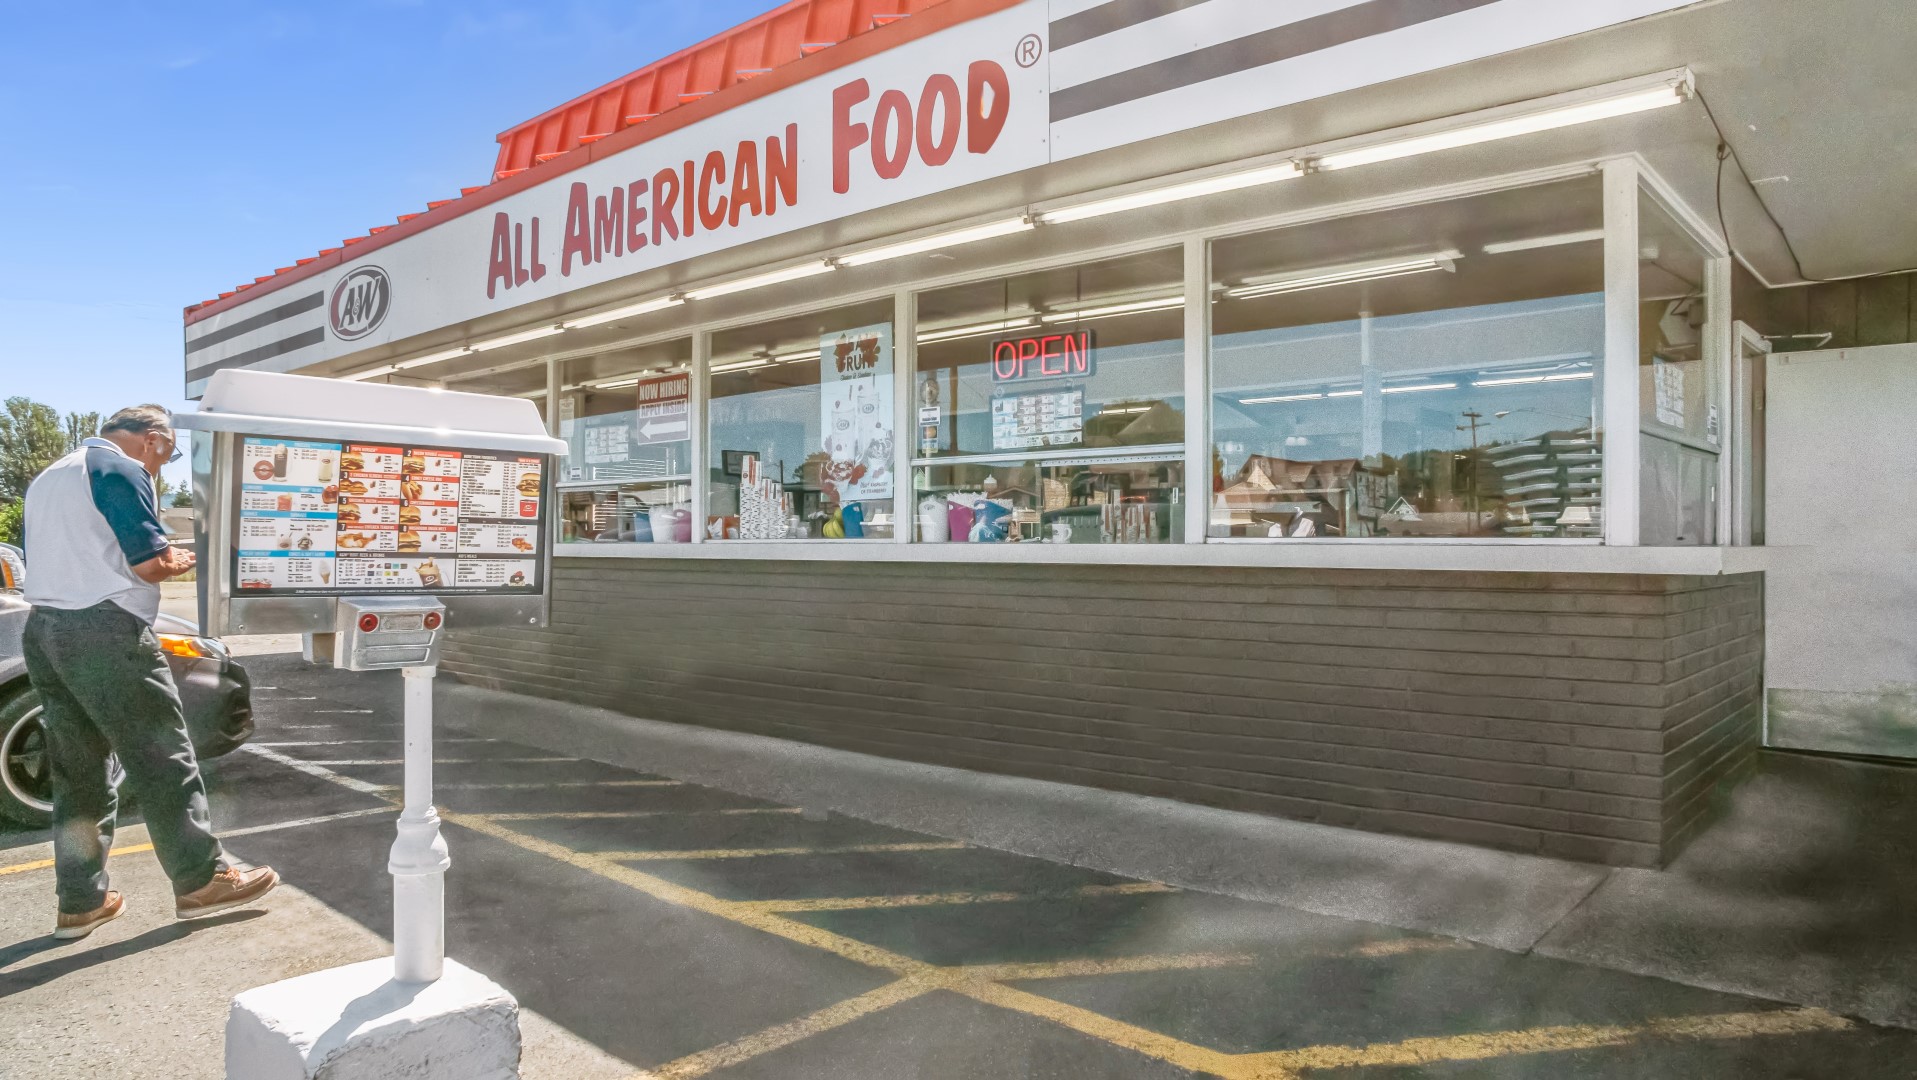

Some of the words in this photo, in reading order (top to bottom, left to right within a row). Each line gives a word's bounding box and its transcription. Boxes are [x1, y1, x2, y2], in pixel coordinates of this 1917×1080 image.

[561, 122, 798, 277] AMERICAN
[832, 59, 1010, 194] FOOD
[995, 333, 1086, 379] OPEN
[640, 382, 659, 401] NOW
[660, 378, 687, 398] HIRING
[641, 402, 661, 417] APPLY
[663, 399, 686, 414] INSIDE
